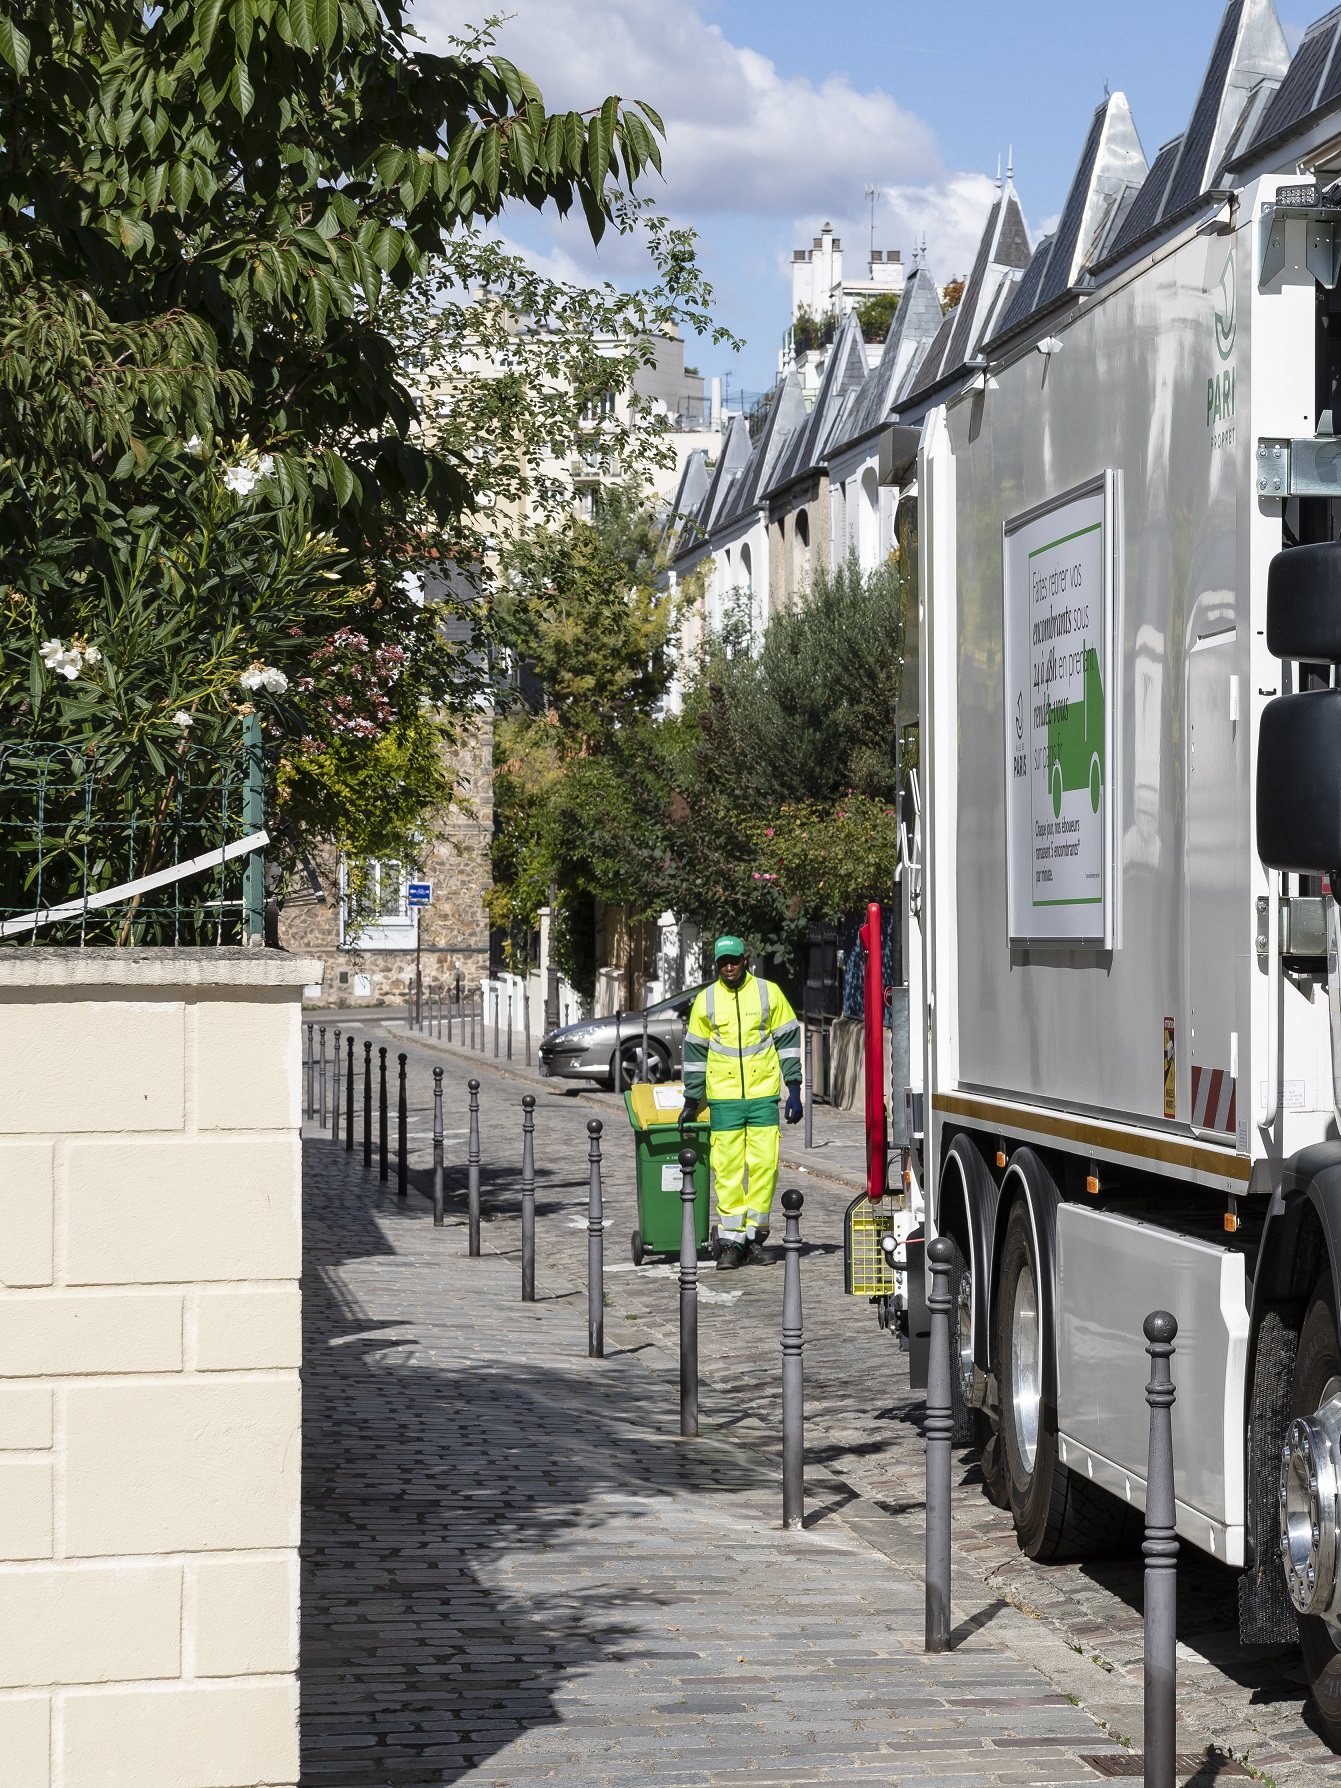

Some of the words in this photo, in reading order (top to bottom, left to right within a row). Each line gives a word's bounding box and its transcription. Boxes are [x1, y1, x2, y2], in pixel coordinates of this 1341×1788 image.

[1207, 366, 1235, 427] PARI
[1033, 572, 1048, 604] Faites
[1049, 563, 1068, 597] retirer
[1070, 564, 1082, 588] vos
[1033, 605, 1072, 646] encombrants
[1074, 605, 1090, 631] sous
[1034, 662, 1040, 693] 24
[1046, 646, 1056, 690] 48h
[1059, 656, 1066, 678] en
[1034, 692, 1070, 729] rendez-vous
[1014, 754, 1026, 778] PARIS
[1034, 746, 1042, 770] sur
[1044, 733, 1062, 778] paris.fr
[1036, 820, 1046, 841] Chaque
